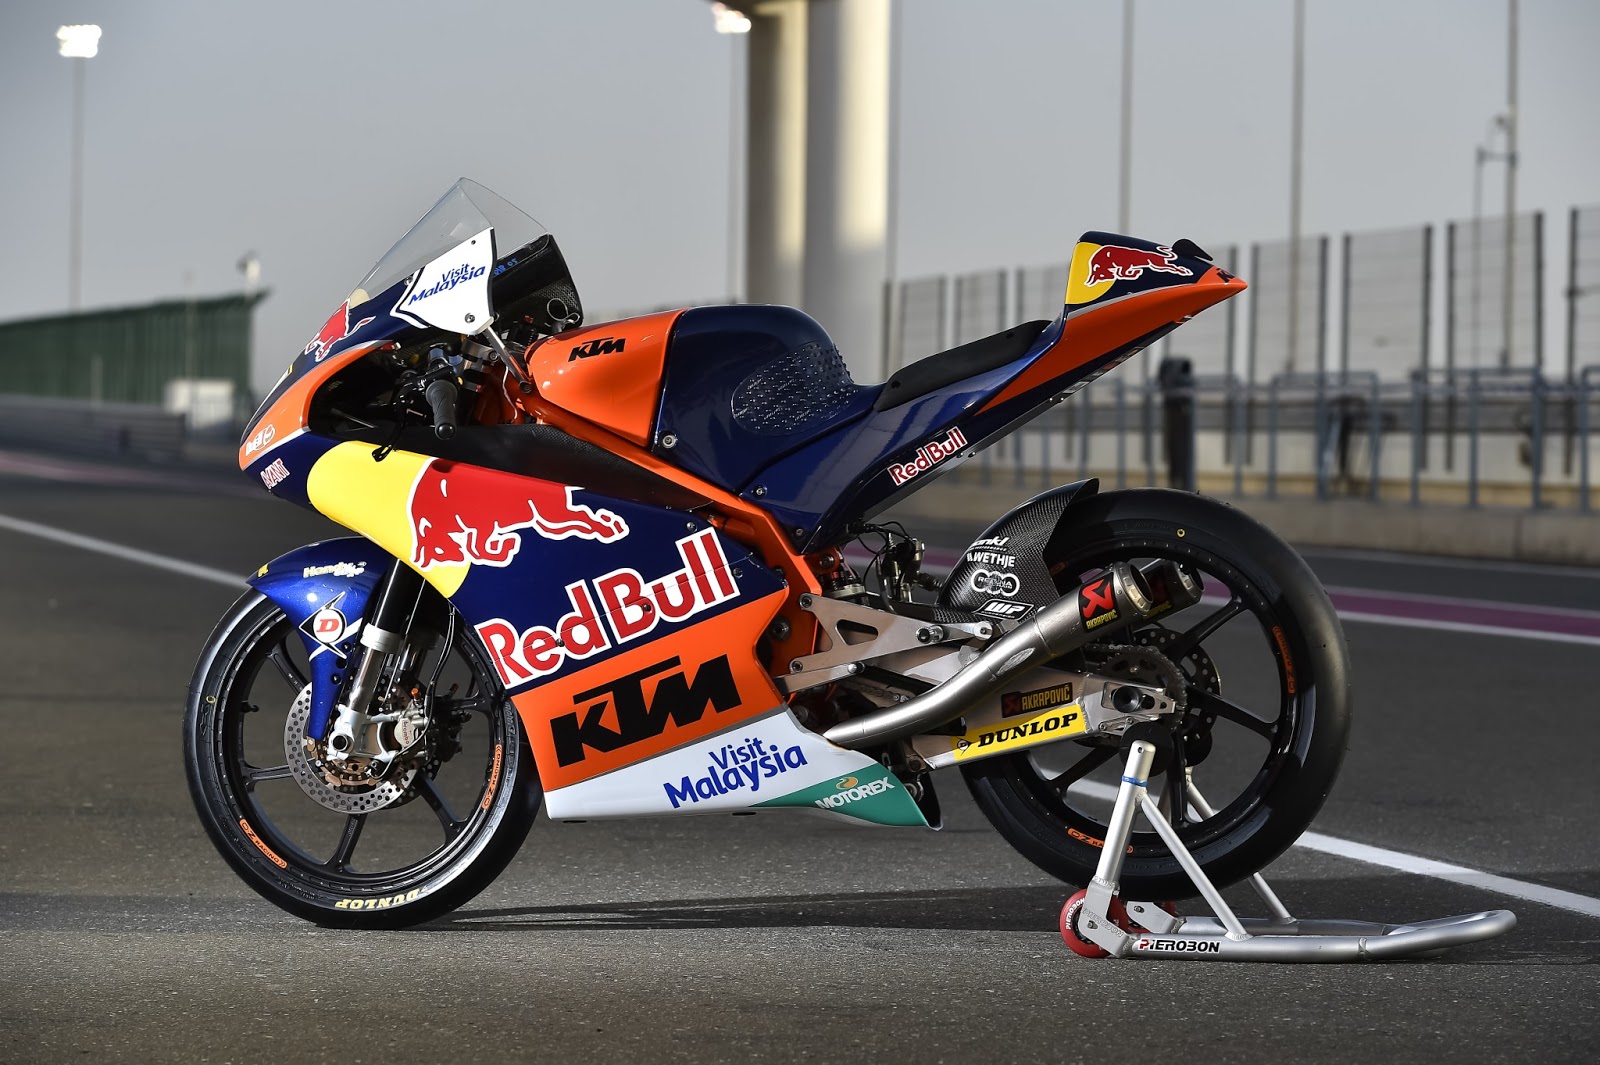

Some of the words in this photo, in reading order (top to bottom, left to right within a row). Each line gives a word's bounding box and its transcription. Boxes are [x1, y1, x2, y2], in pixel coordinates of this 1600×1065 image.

[408, 266, 485, 305] Malaysia
[442, 263, 470, 282] Visit
[568, 336, 626, 362] KTM
[887, 447, 932, 486] Red
[923, 426, 968, 464] Bull
[974, 552, 1016, 568] WETHJE
[474, 579, 611, 689] Red
[594, 527, 740, 644] Bull
[985, 602, 1025, 614] WP
[316, 618, 340, 633] D
[550, 654, 742, 768] KTM
[1022, 684, 1070, 711] AKRAPOVIČ
[977, 713, 1078, 748] DUNLOP
[492, 753, 501, 785] RACING
[709, 737, 767, 770] Visit
[663, 745, 808, 809] Malaysia
[815, 776, 896, 809] MOTOREX
[255, 840, 280, 863] RACING
[335, 888, 420, 909] DUNLOP
